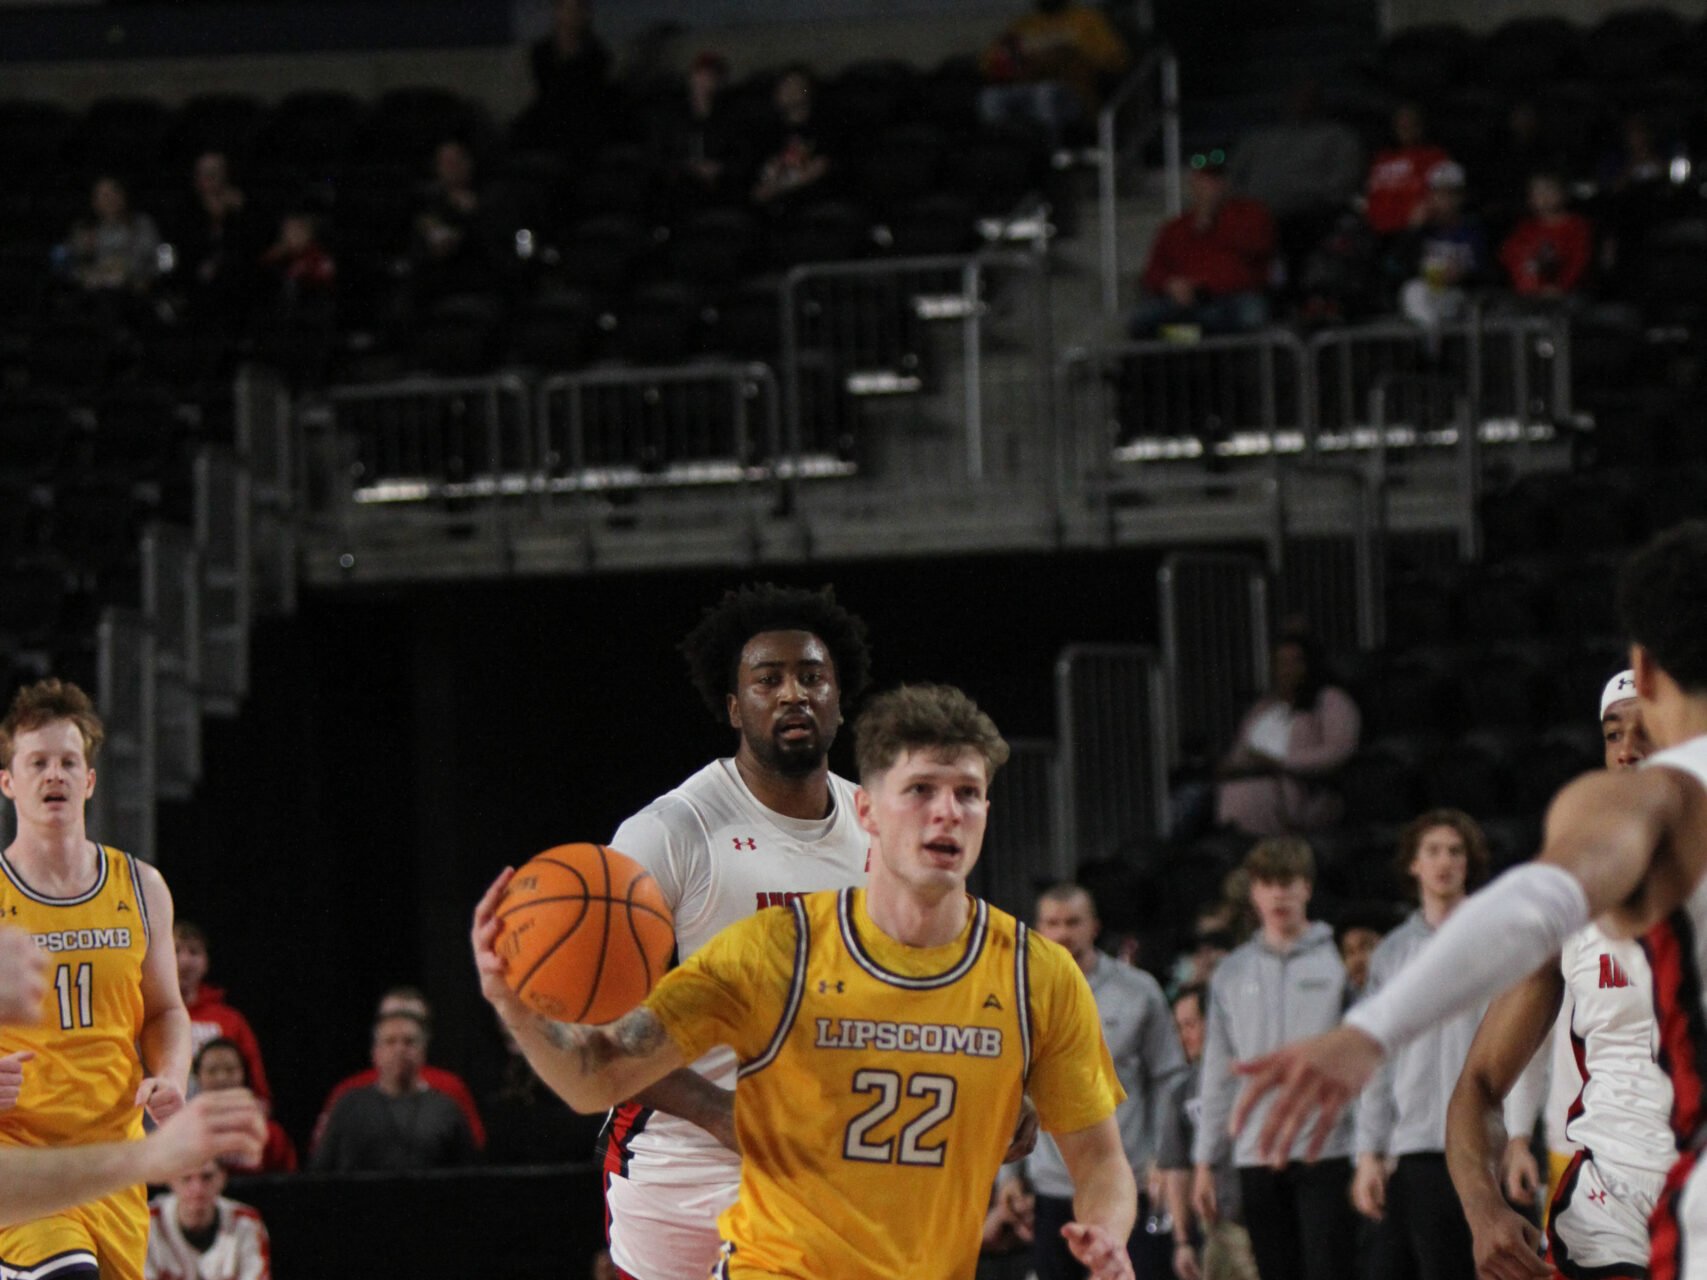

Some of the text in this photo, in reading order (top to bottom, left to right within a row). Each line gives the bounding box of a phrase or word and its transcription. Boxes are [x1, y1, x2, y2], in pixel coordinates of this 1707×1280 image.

[32, 927, 132, 953] PSCOMB
[54, 962, 93, 1030] 11
[815, 1017, 1003, 1058] LIPSCOMB
[842, 1067, 958, 1167] 22
